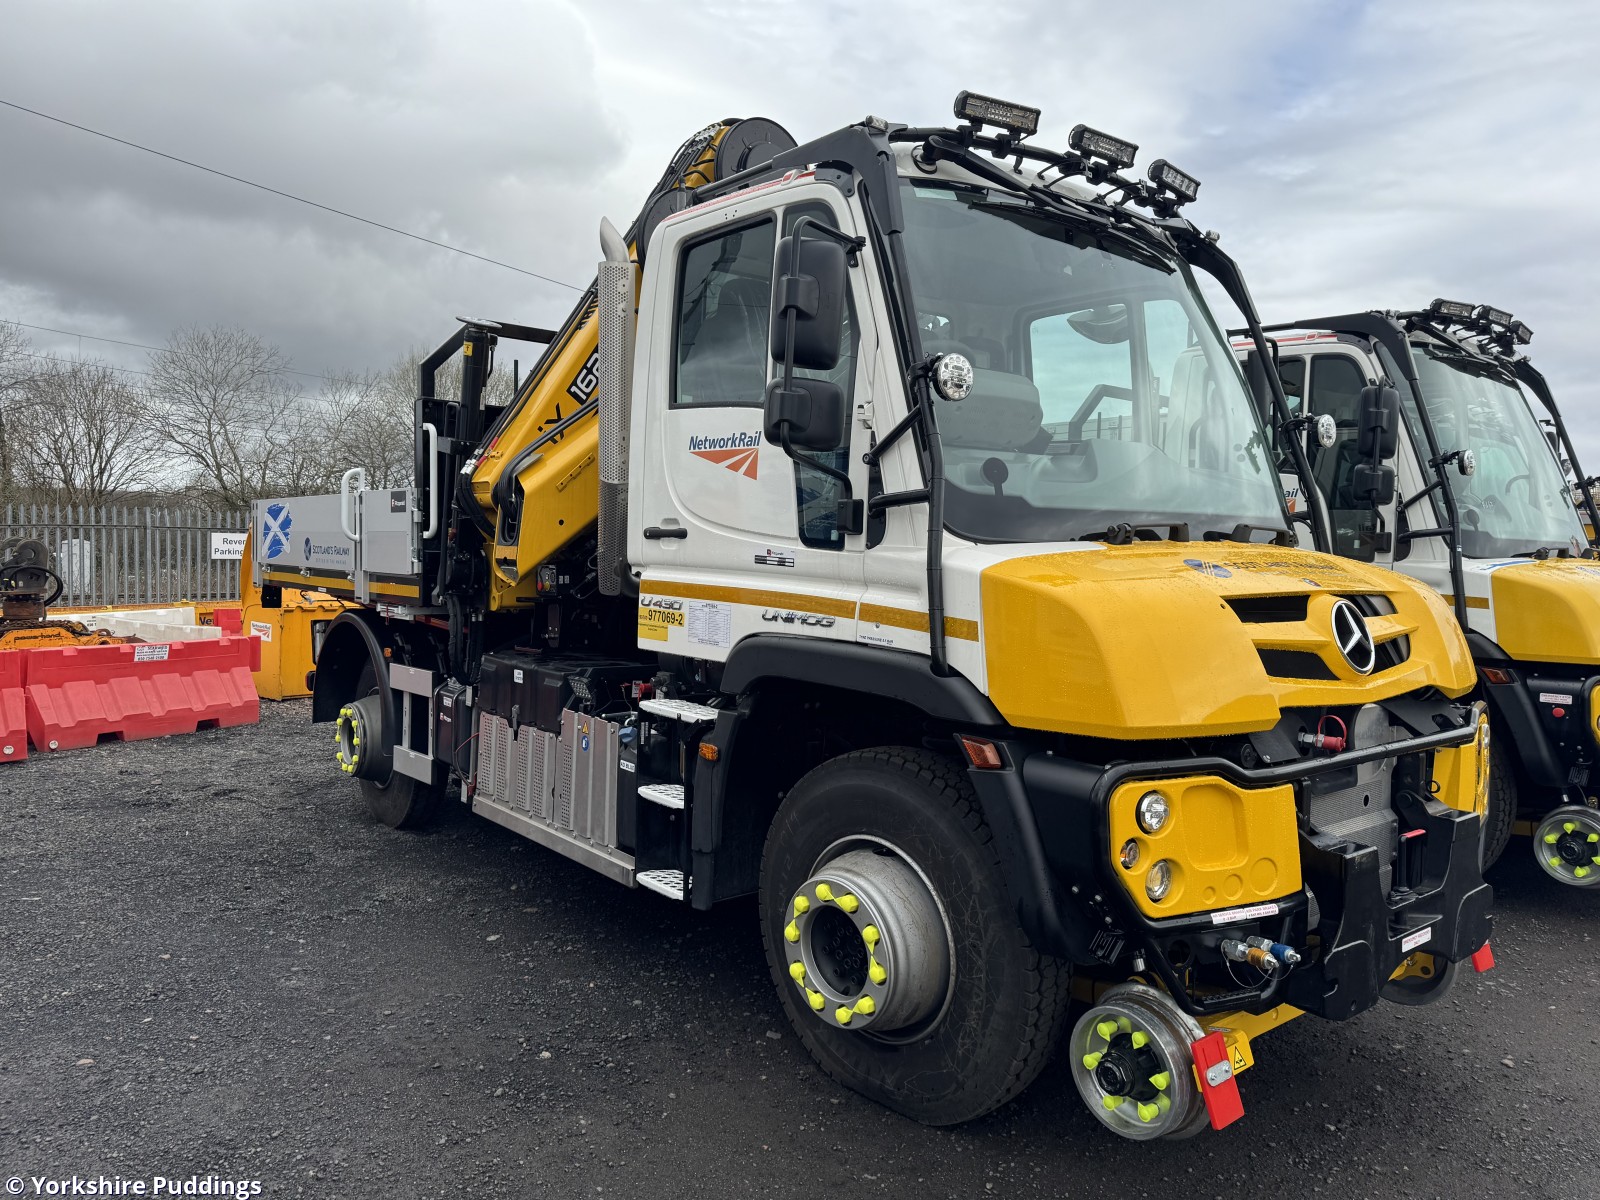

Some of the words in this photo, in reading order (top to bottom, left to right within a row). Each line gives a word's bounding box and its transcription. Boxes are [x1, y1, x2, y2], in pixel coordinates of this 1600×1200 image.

[688, 430, 762, 451] NetworkRail
[648, 609, 683, 626] 977069-2
[761, 609, 836, 628] UNIMOG
